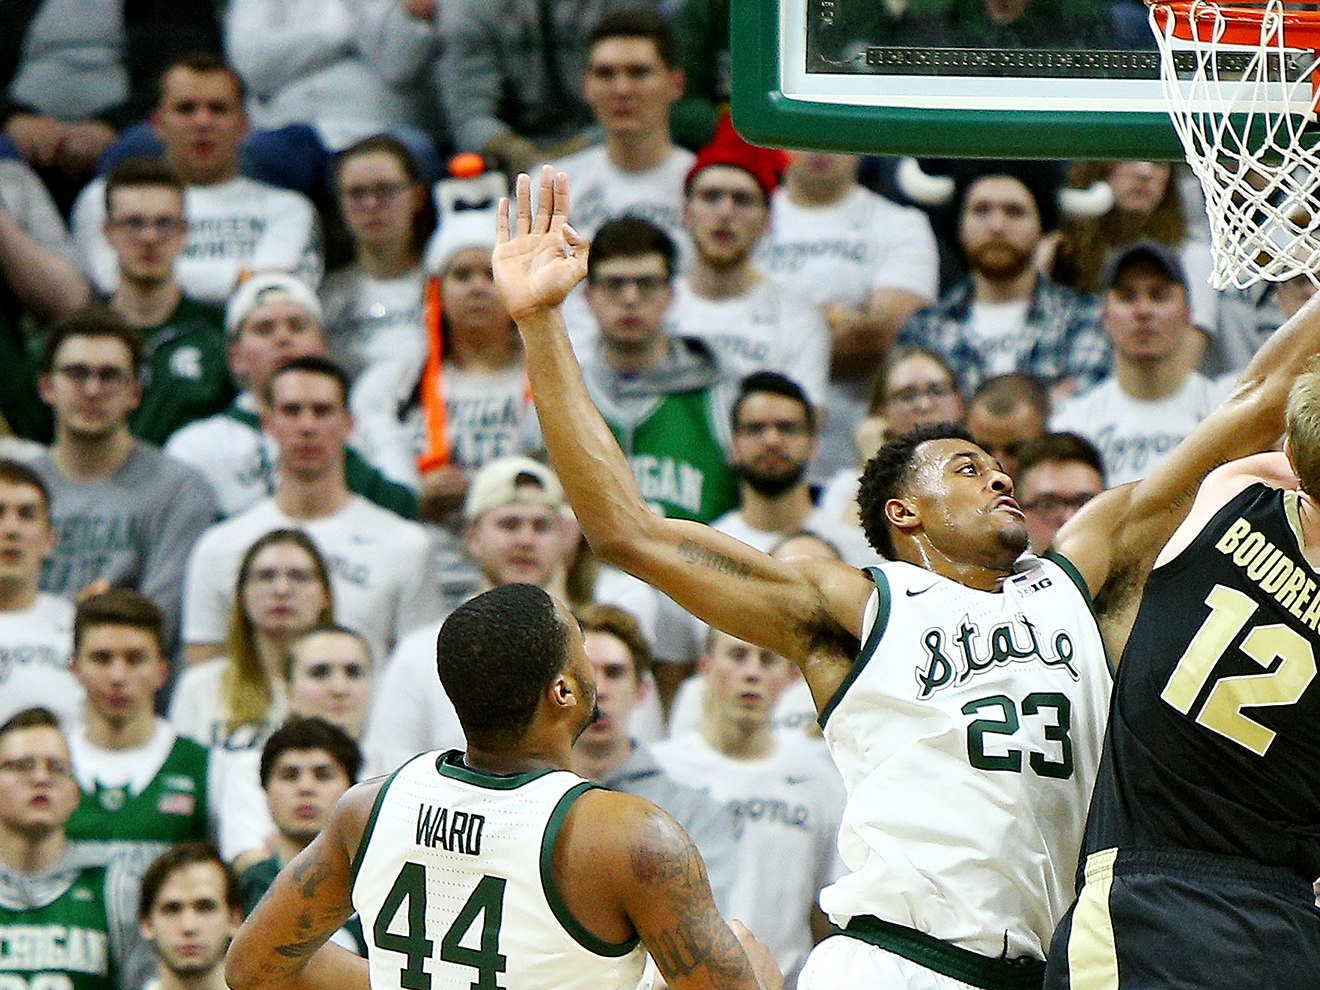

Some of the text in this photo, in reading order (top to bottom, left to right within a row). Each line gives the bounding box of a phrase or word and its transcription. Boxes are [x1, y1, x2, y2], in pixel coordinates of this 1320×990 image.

[915, 613, 1083, 700] State
[1160, 583, 1318, 757] 12
[961, 692, 1075, 780] 23
[415, 803, 486, 856] WARD
